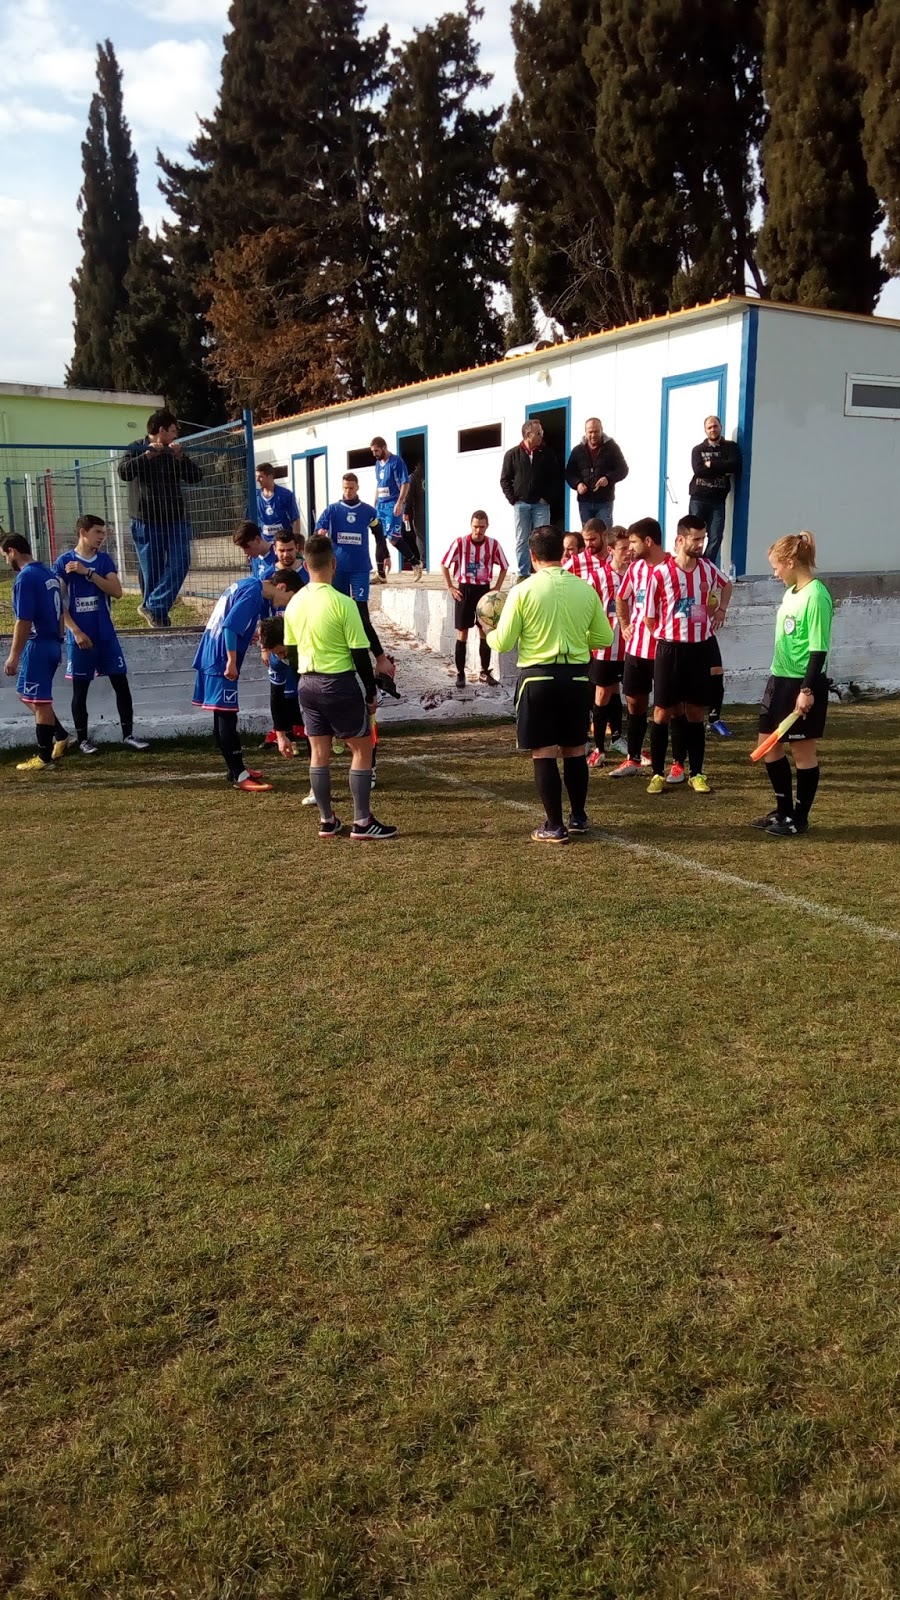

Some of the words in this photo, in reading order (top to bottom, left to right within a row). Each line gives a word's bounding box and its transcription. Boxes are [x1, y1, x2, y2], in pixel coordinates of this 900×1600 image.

[337, 532, 361, 541] Seasons
[359, 587, 364, 597] 2
[118, 656, 124, 668] 3
